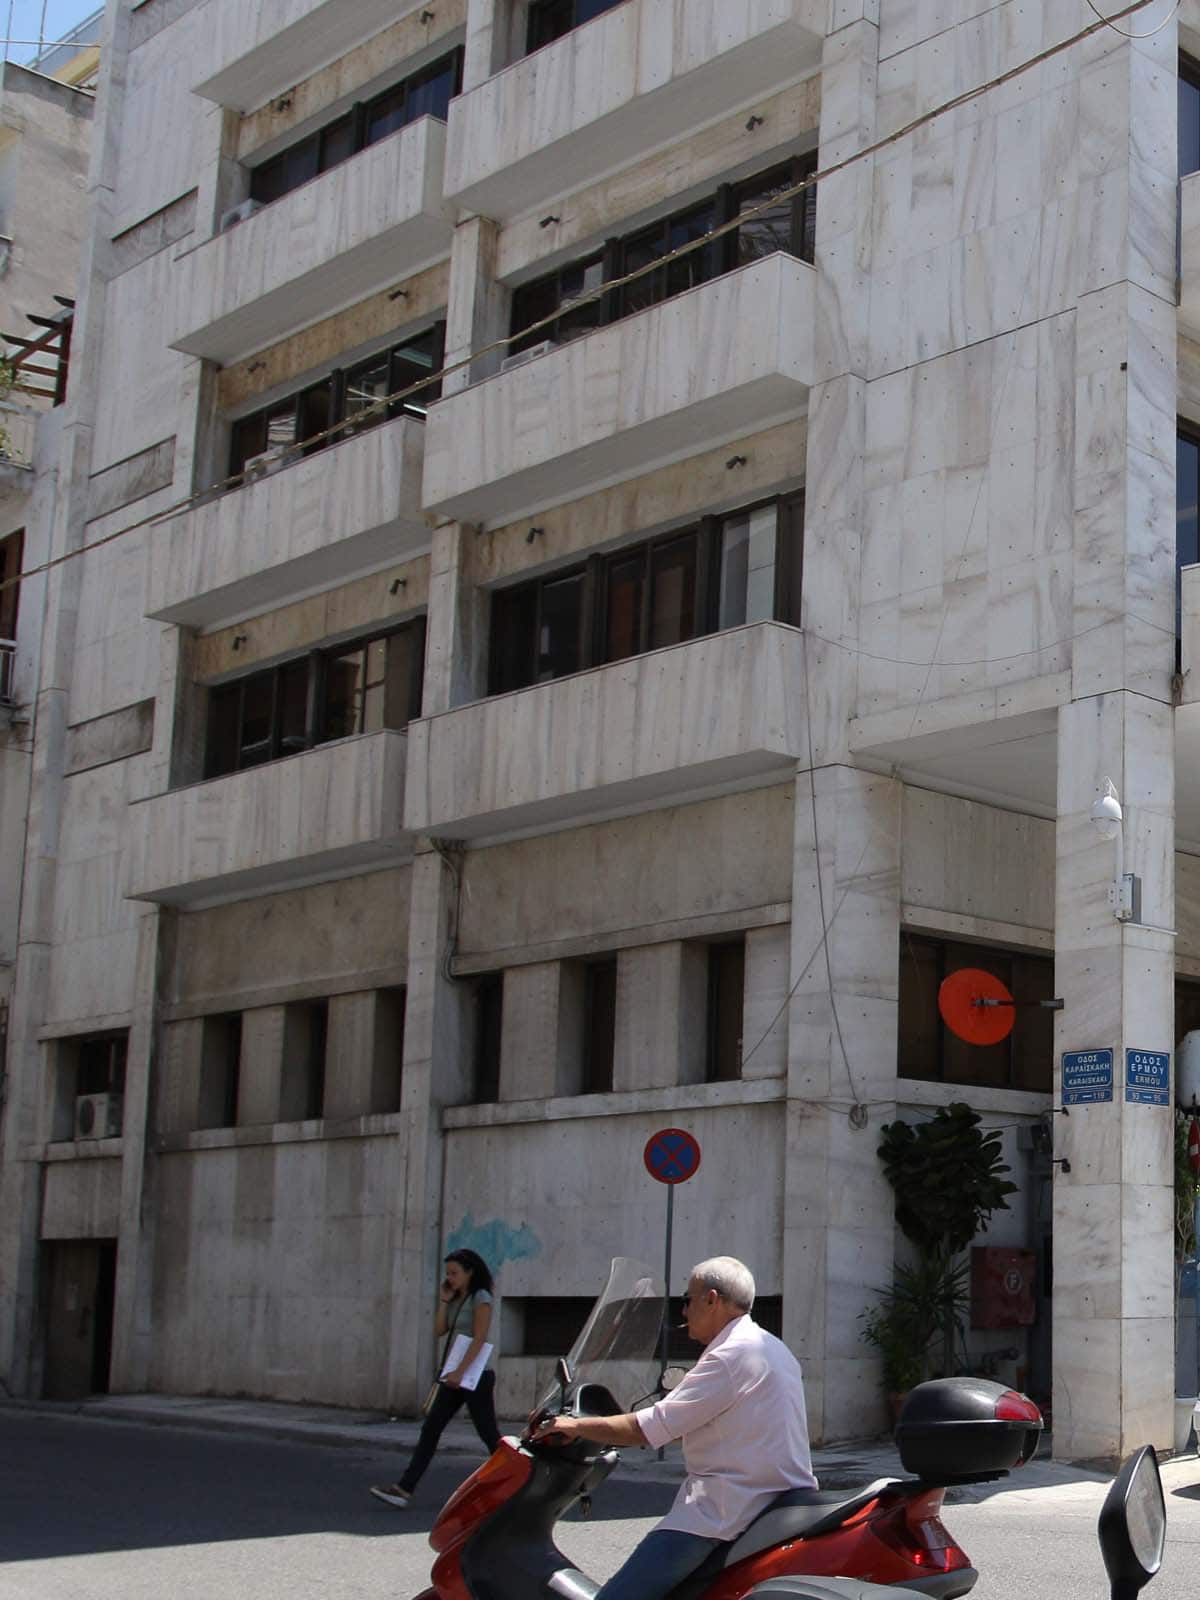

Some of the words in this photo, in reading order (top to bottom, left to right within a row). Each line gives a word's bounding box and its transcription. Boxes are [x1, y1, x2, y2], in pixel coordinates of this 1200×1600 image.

[1077, 1055, 1097, 1064] ΟΔΟΣ
[1134, 1055, 1161, 1066] ΟΔΟΣ
[1131, 1063, 1164, 1075] ΕΡΜΟΥ
[1068, 1076, 1107, 1085] KARAISKAKI
[1135, 1075, 1161, 1085] ERMOU
